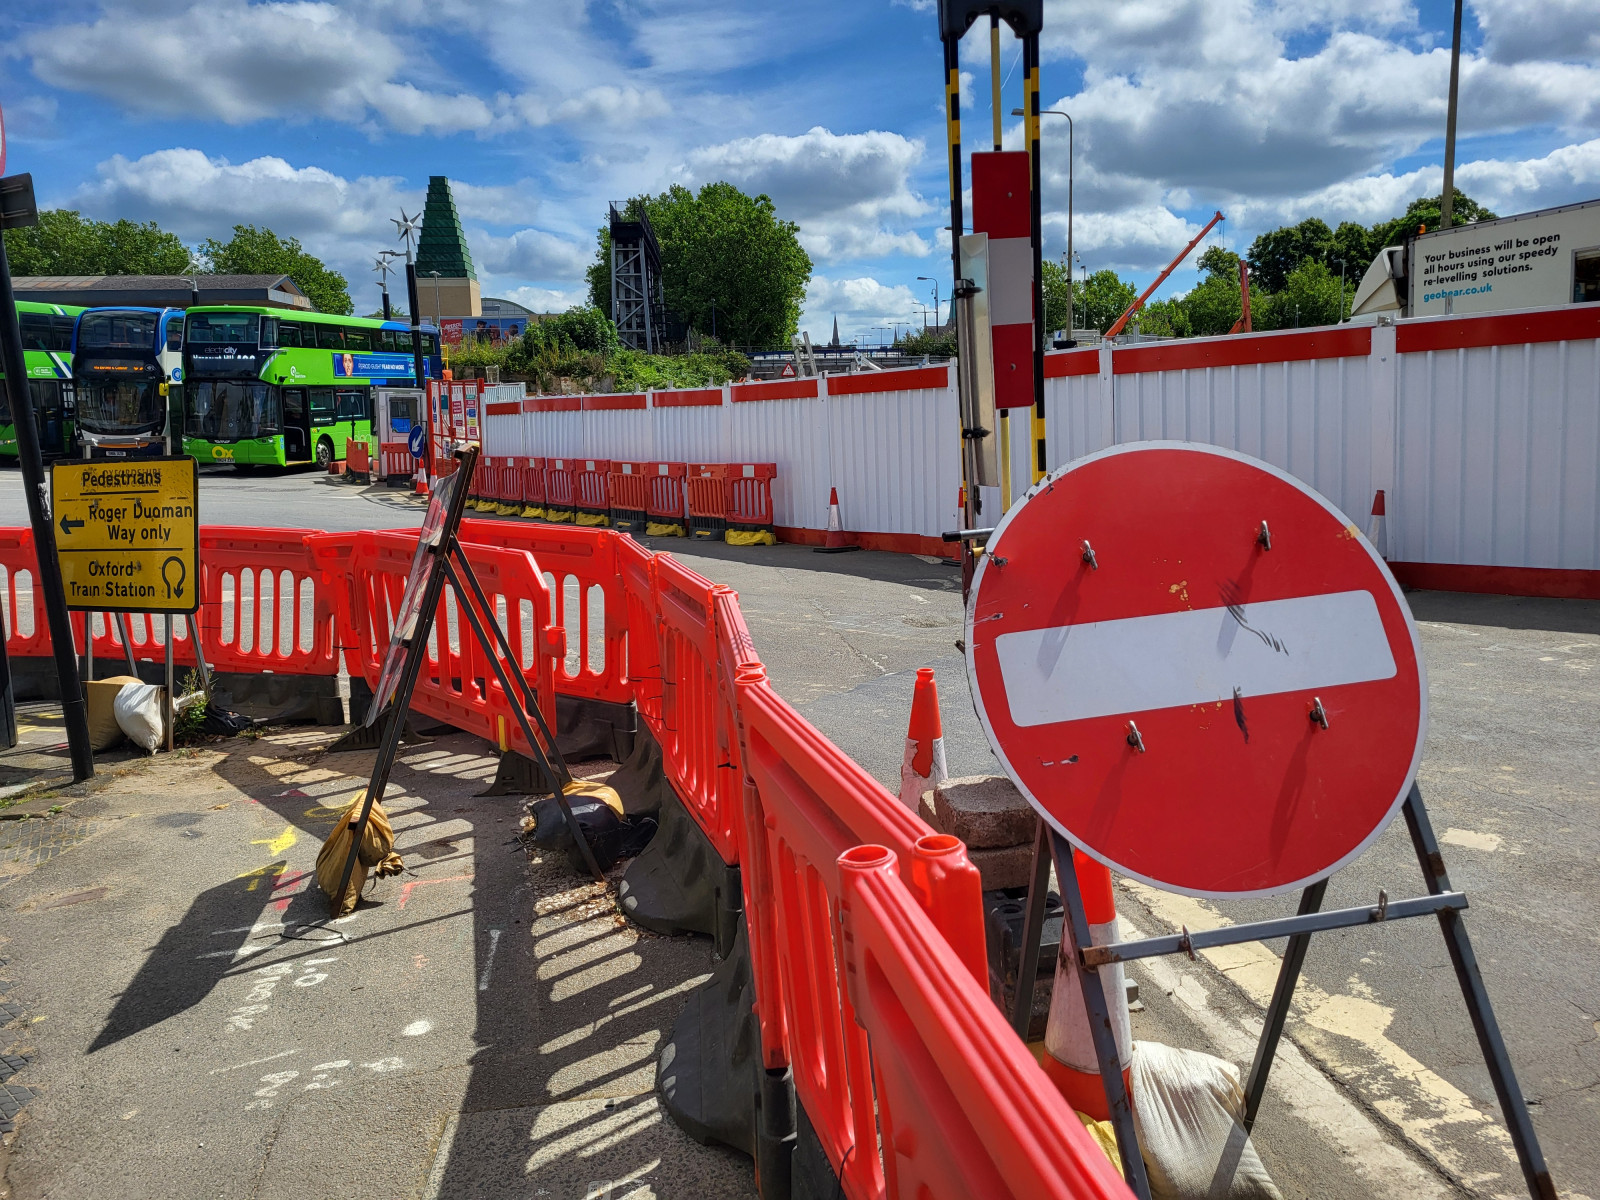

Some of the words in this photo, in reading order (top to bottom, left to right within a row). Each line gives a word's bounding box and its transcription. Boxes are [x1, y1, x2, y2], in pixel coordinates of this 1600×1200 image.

[1424, 253, 1446, 264] Your
[1448, 246, 1490, 260] business
[1494, 240, 1513, 252] will
[1516, 238, 1529, 249] be
[1532, 233, 1560, 248] open
[1424, 266, 1435, 275] all
[1437, 262, 1465, 273] hours
[1467, 256, 1494, 269] using
[1498, 253, 1515, 263] our
[1519, 246, 1558, 260] speedy
[1423, 271, 1477, 287] re-levelling
[1482, 264, 1533, 278] solutions.
[212, 445, 234, 458] Ox
[82, 470, 162, 487] Pedestrians
[88, 504, 127, 523] Roger
[107, 525, 136, 543] Way
[141, 524, 171, 542] only
[88, 561, 133, 577] Oxford
[70, 581, 100, 597] Train
[105, 581, 155, 597] Station
